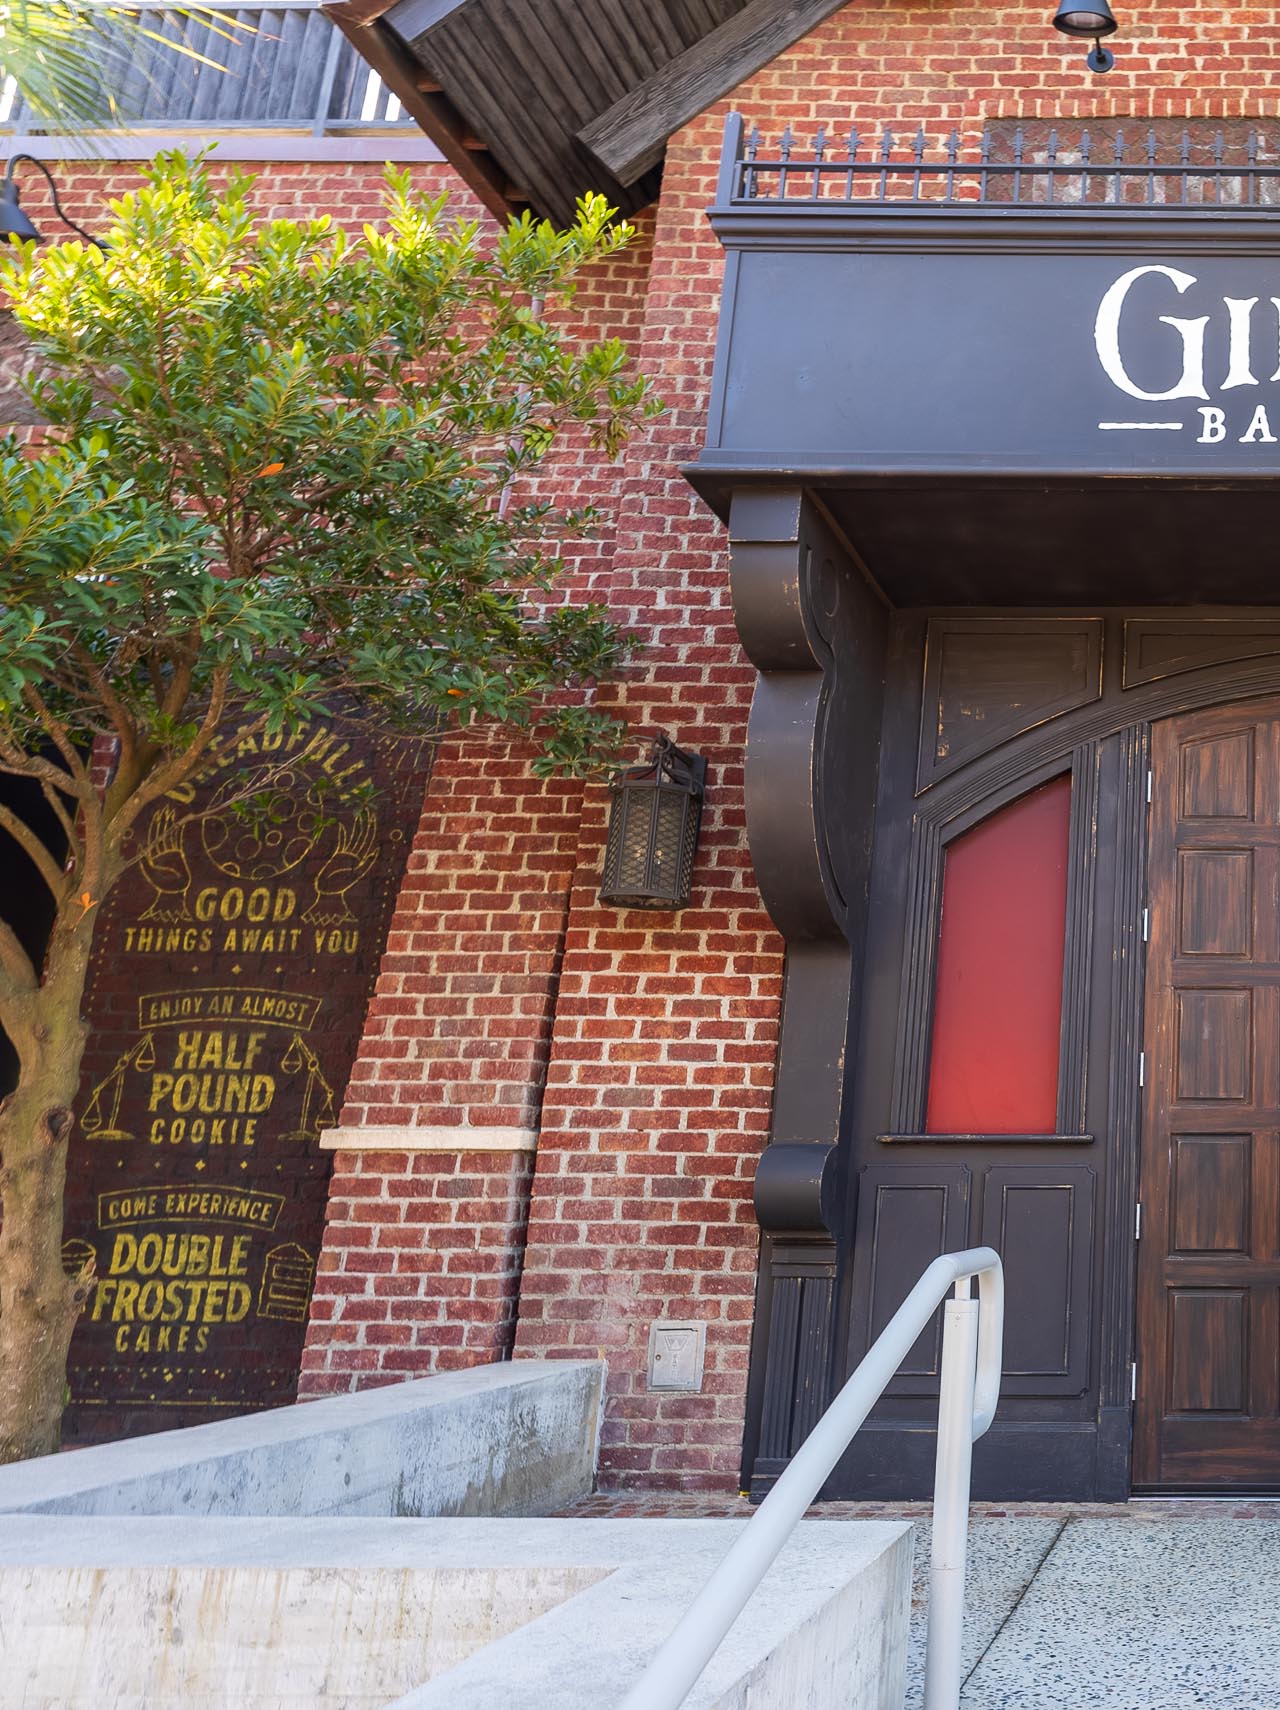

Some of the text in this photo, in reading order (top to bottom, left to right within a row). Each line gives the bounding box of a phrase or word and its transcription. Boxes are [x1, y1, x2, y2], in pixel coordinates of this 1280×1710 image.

[195, 887, 297, 922] GOOD
[124, 928, 359, 954] THINGS AWAIT YOU
[149, 996, 309, 1022] ENJOY AN ALMOST
[174, 1031, 267, 1070] HALF
[147, 1074, 275, 1113] POUND
[150, 1118, 257, 1145] COOKIE
[108, 1193, 273, 1222] COME EXPERIENCE
[109, 1233, 253, 1276] DOUBLE
[91, 1279, 252, 1323] FROSTED
[115, 1325, 211, 1353] CAKES
